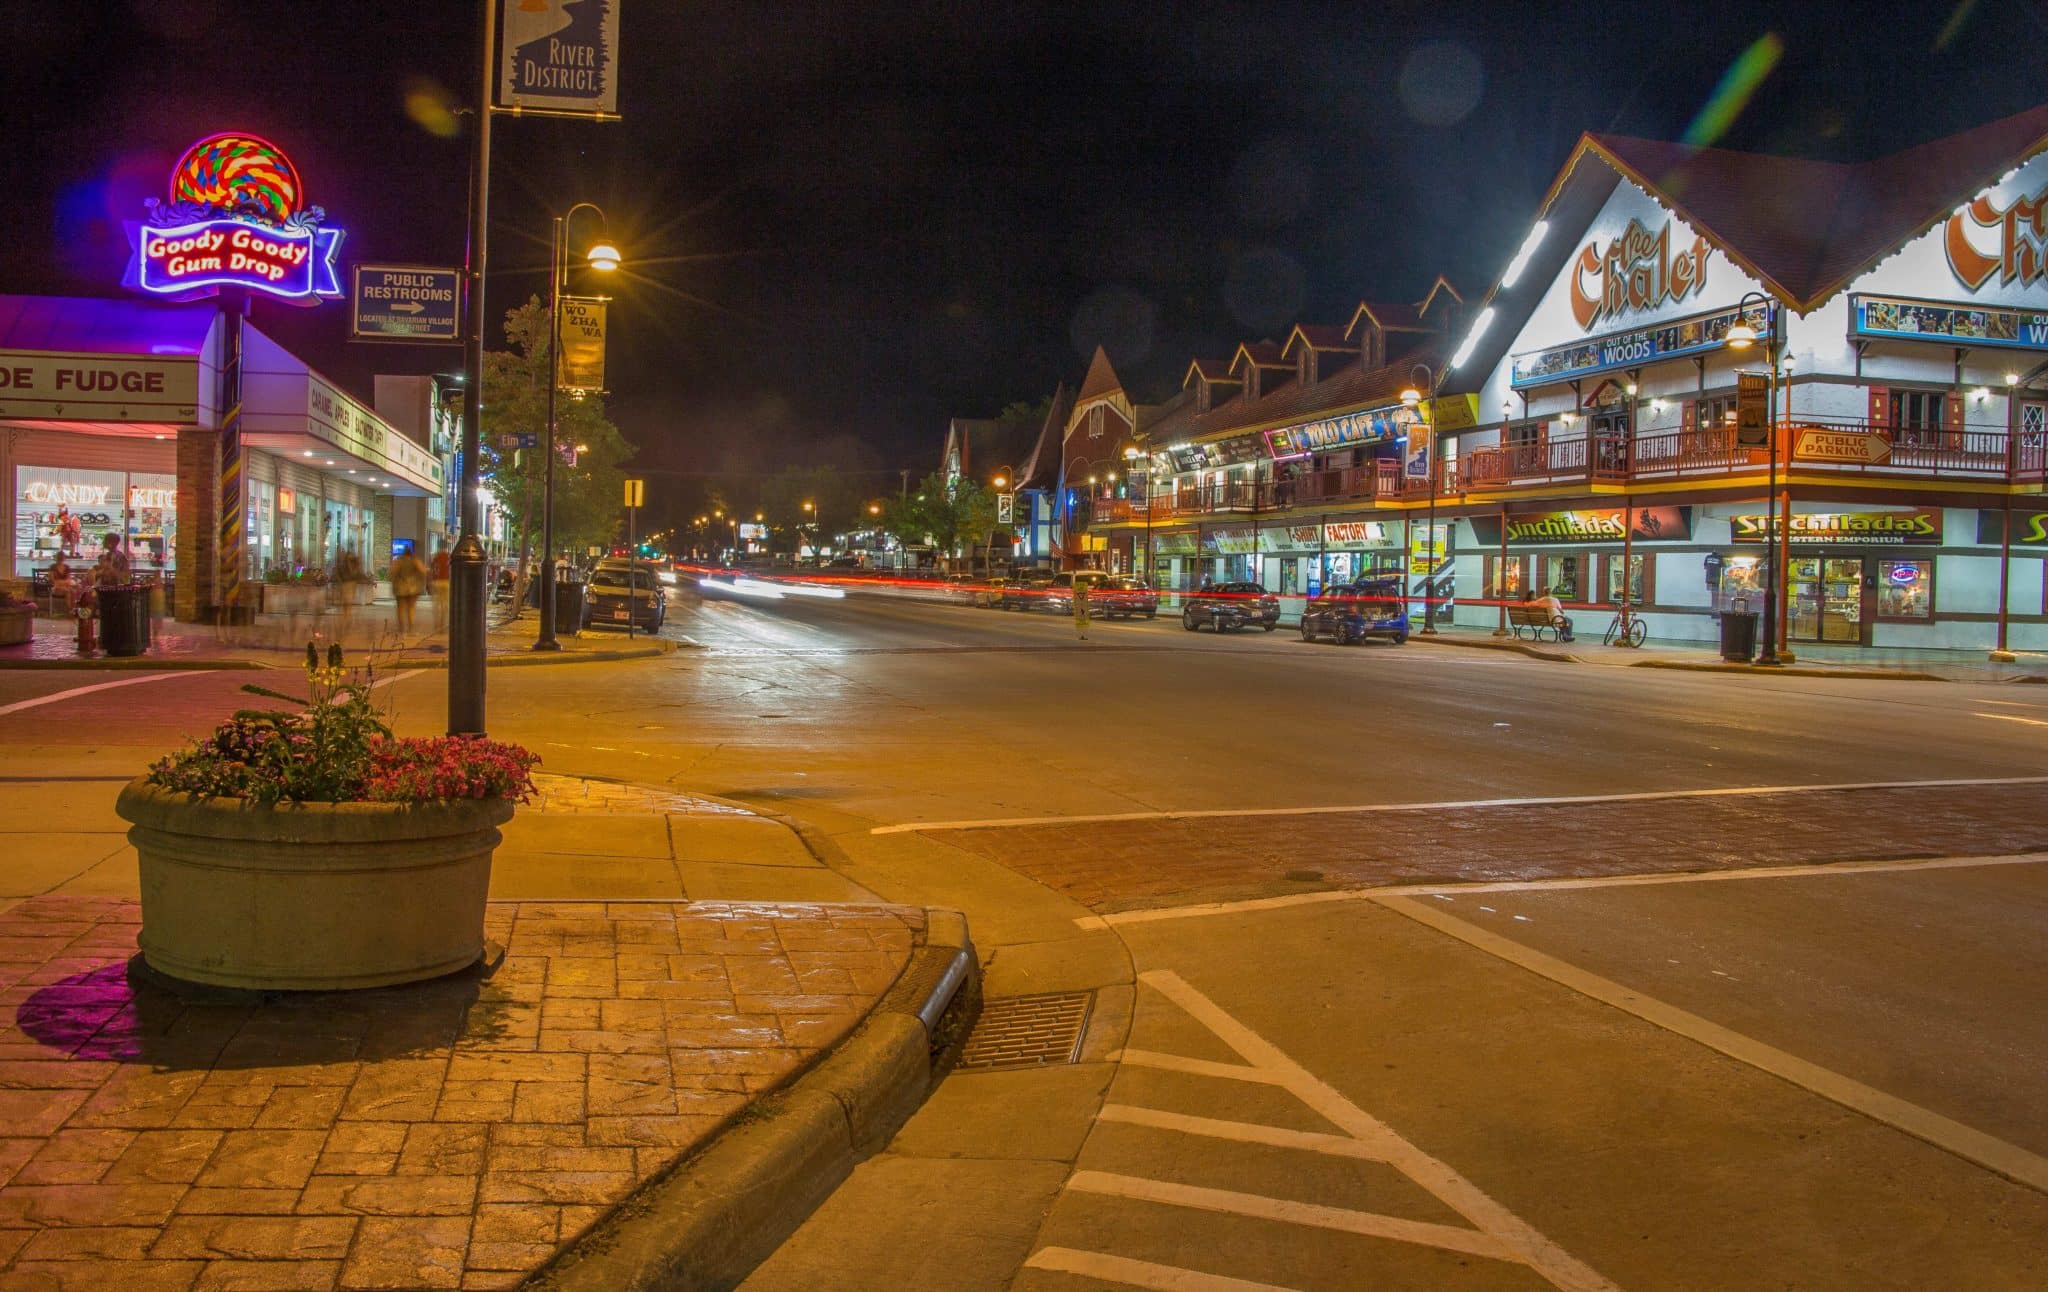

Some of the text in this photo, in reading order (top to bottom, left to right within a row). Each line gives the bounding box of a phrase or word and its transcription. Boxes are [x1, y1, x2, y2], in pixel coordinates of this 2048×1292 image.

[550, 38, 595, 67] RIVER
[147, 229, 308, 264] Goody Goody
[167, 253, 285, 281] Gum Drop
[1570, 217, 1713, 333] Chalet
[383, 273, 434, 288] PUBLIC
[364, 286, 453, 301] RESTROOMS
[1606, 331, 1648, 347] OUT OF THE
[1604, 340, 1650, 365] WOODS
[55, 369, 165, 393] FUDGE
[1340, 413, 1376, 443] CAFE
[1805, 444, 1869, 457] PARKING
[1815, 435, 1867, 448] PUBLIC
[26, 481, 111, 505] CANDY
[1285, 526, 1319, 543] T-SHIRT
[1326, 522, 1368, 543] FACTORY
[1836, 536, 1905, 544] EMPORIUM
